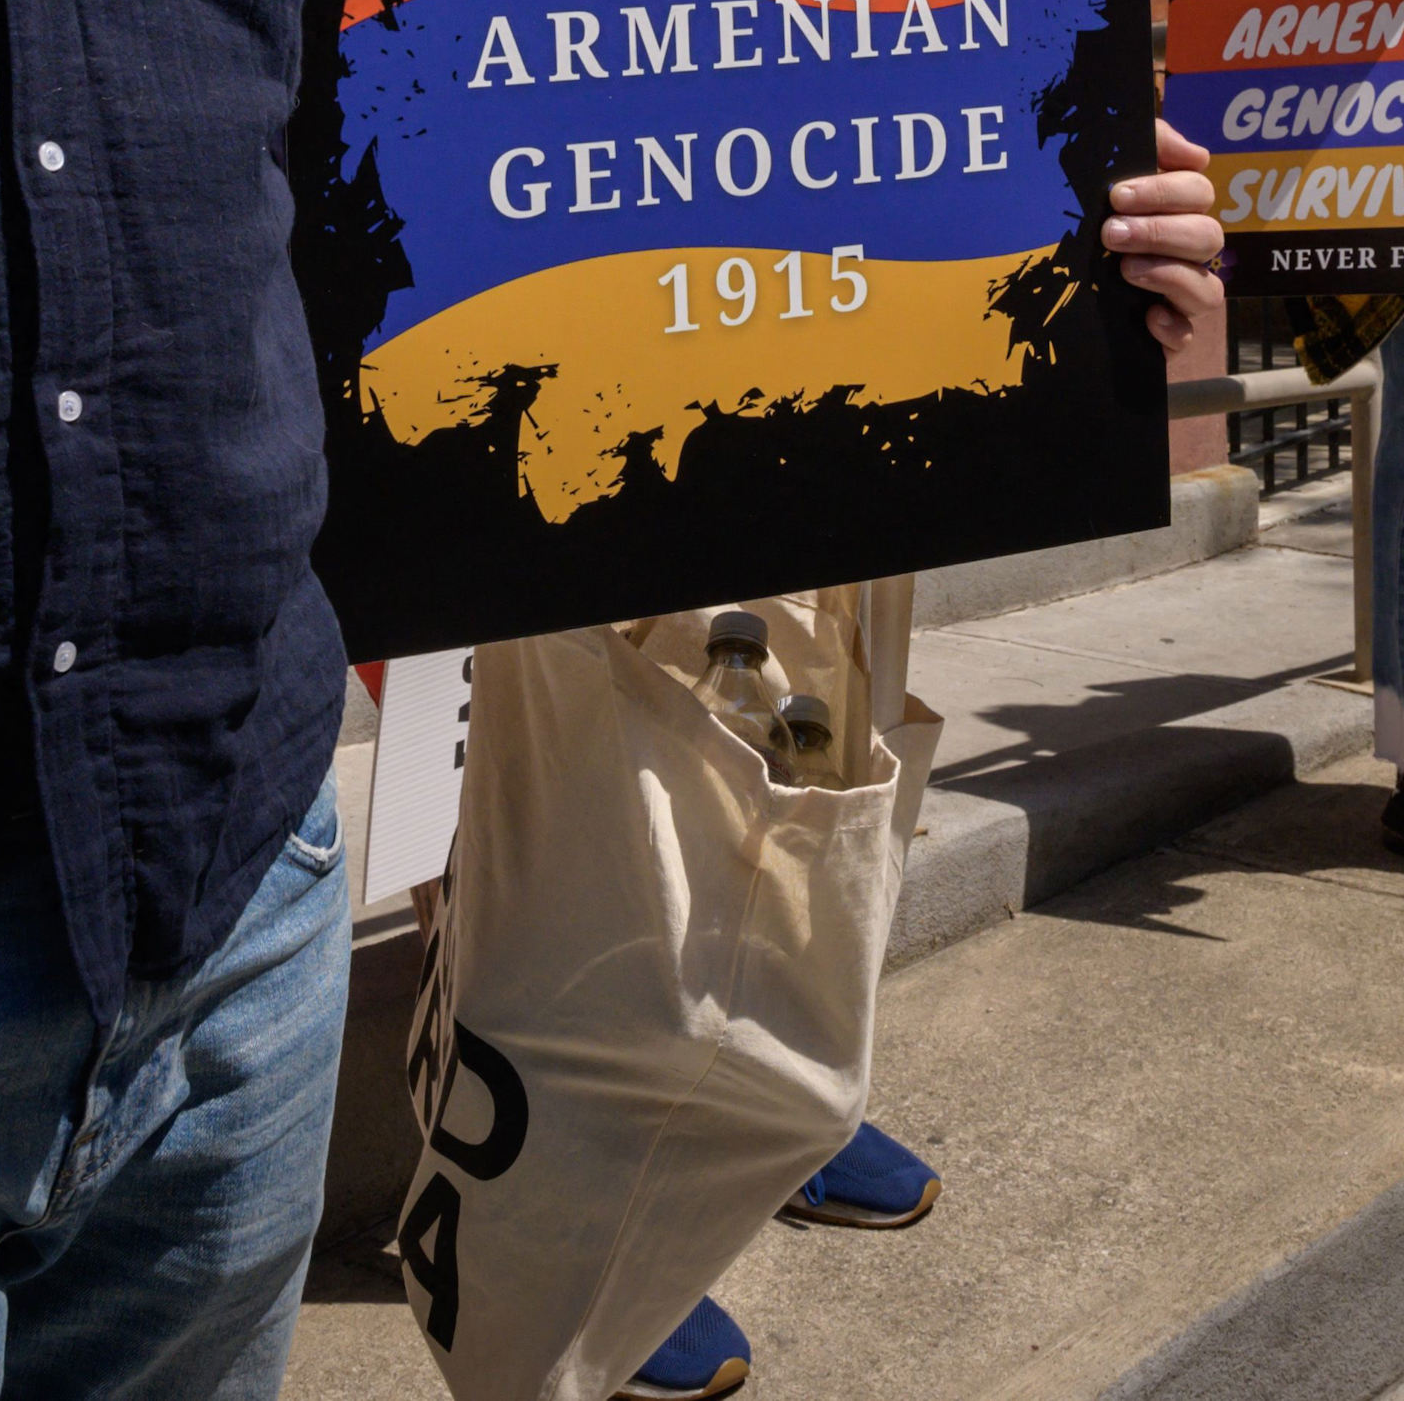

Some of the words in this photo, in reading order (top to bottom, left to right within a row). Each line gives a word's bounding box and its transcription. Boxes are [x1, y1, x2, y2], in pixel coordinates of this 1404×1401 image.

[489, 105, 1008, 219] GENOCIDE
[658, 244, 868, 334] 1915
[1271, 247, 1377, 271] NEVER
